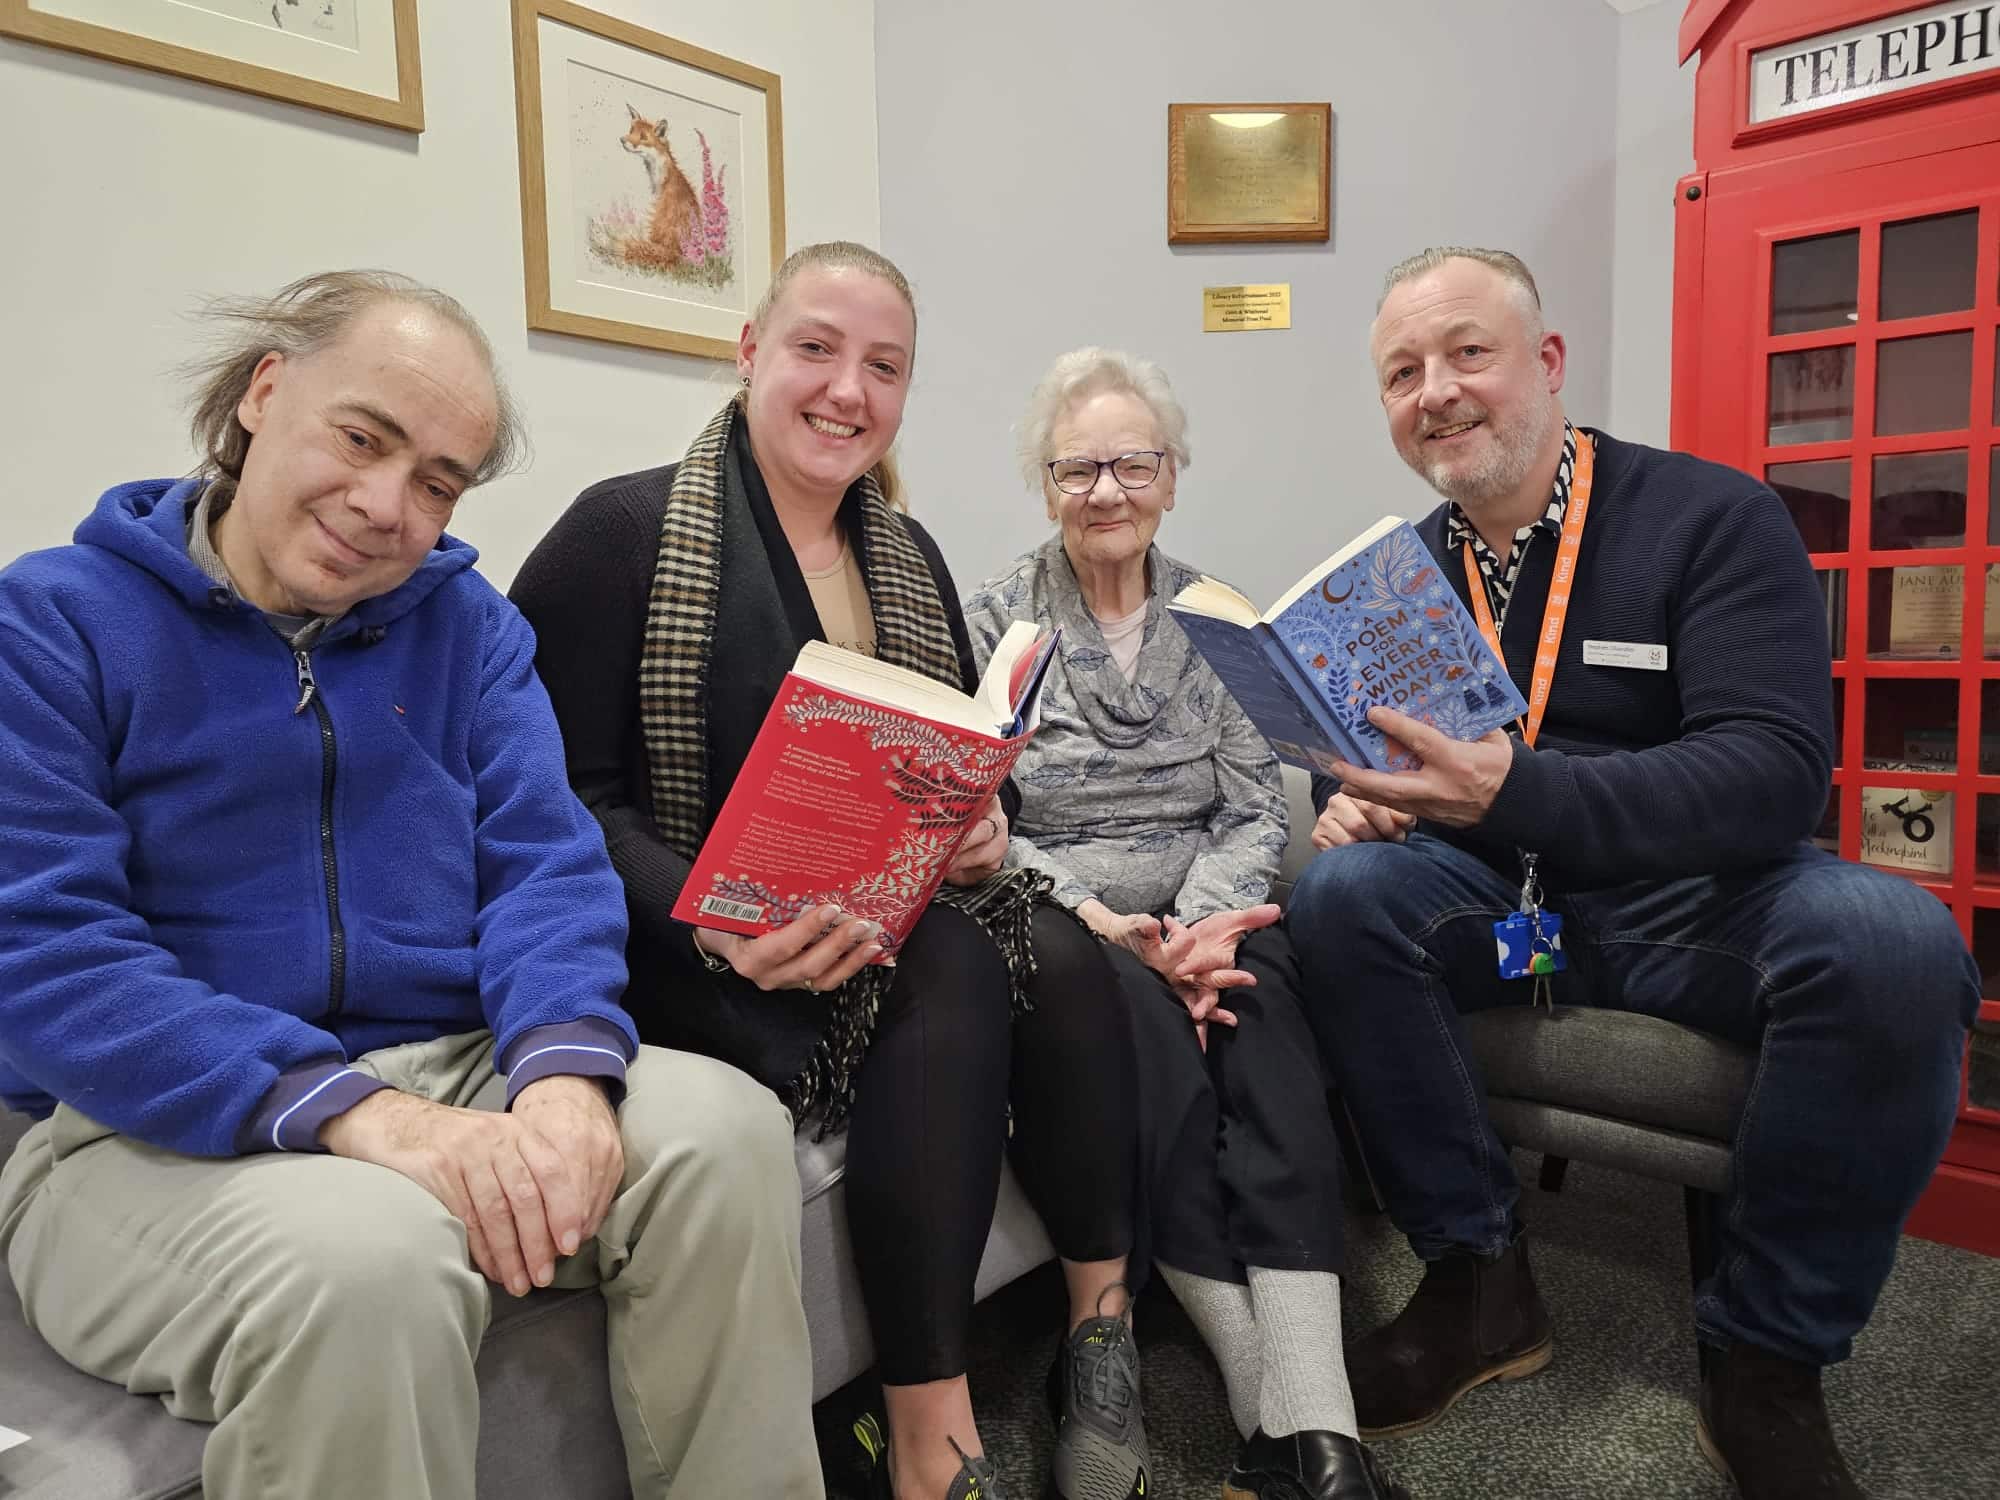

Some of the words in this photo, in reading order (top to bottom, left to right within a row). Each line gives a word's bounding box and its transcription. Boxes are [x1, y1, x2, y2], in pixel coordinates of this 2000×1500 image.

[1774, 6, 2000, 107] TELEPH
[1345, 608, 1409, 657] POEM
[1363, 616, 1374, 627] A
[1371, 635, 1398, 655] FOR
[1360, 633, 1425, 682] EVERY
[1366, 648, 1444, 699] WINTER
[1391, 671, 1432, 705] DAY
